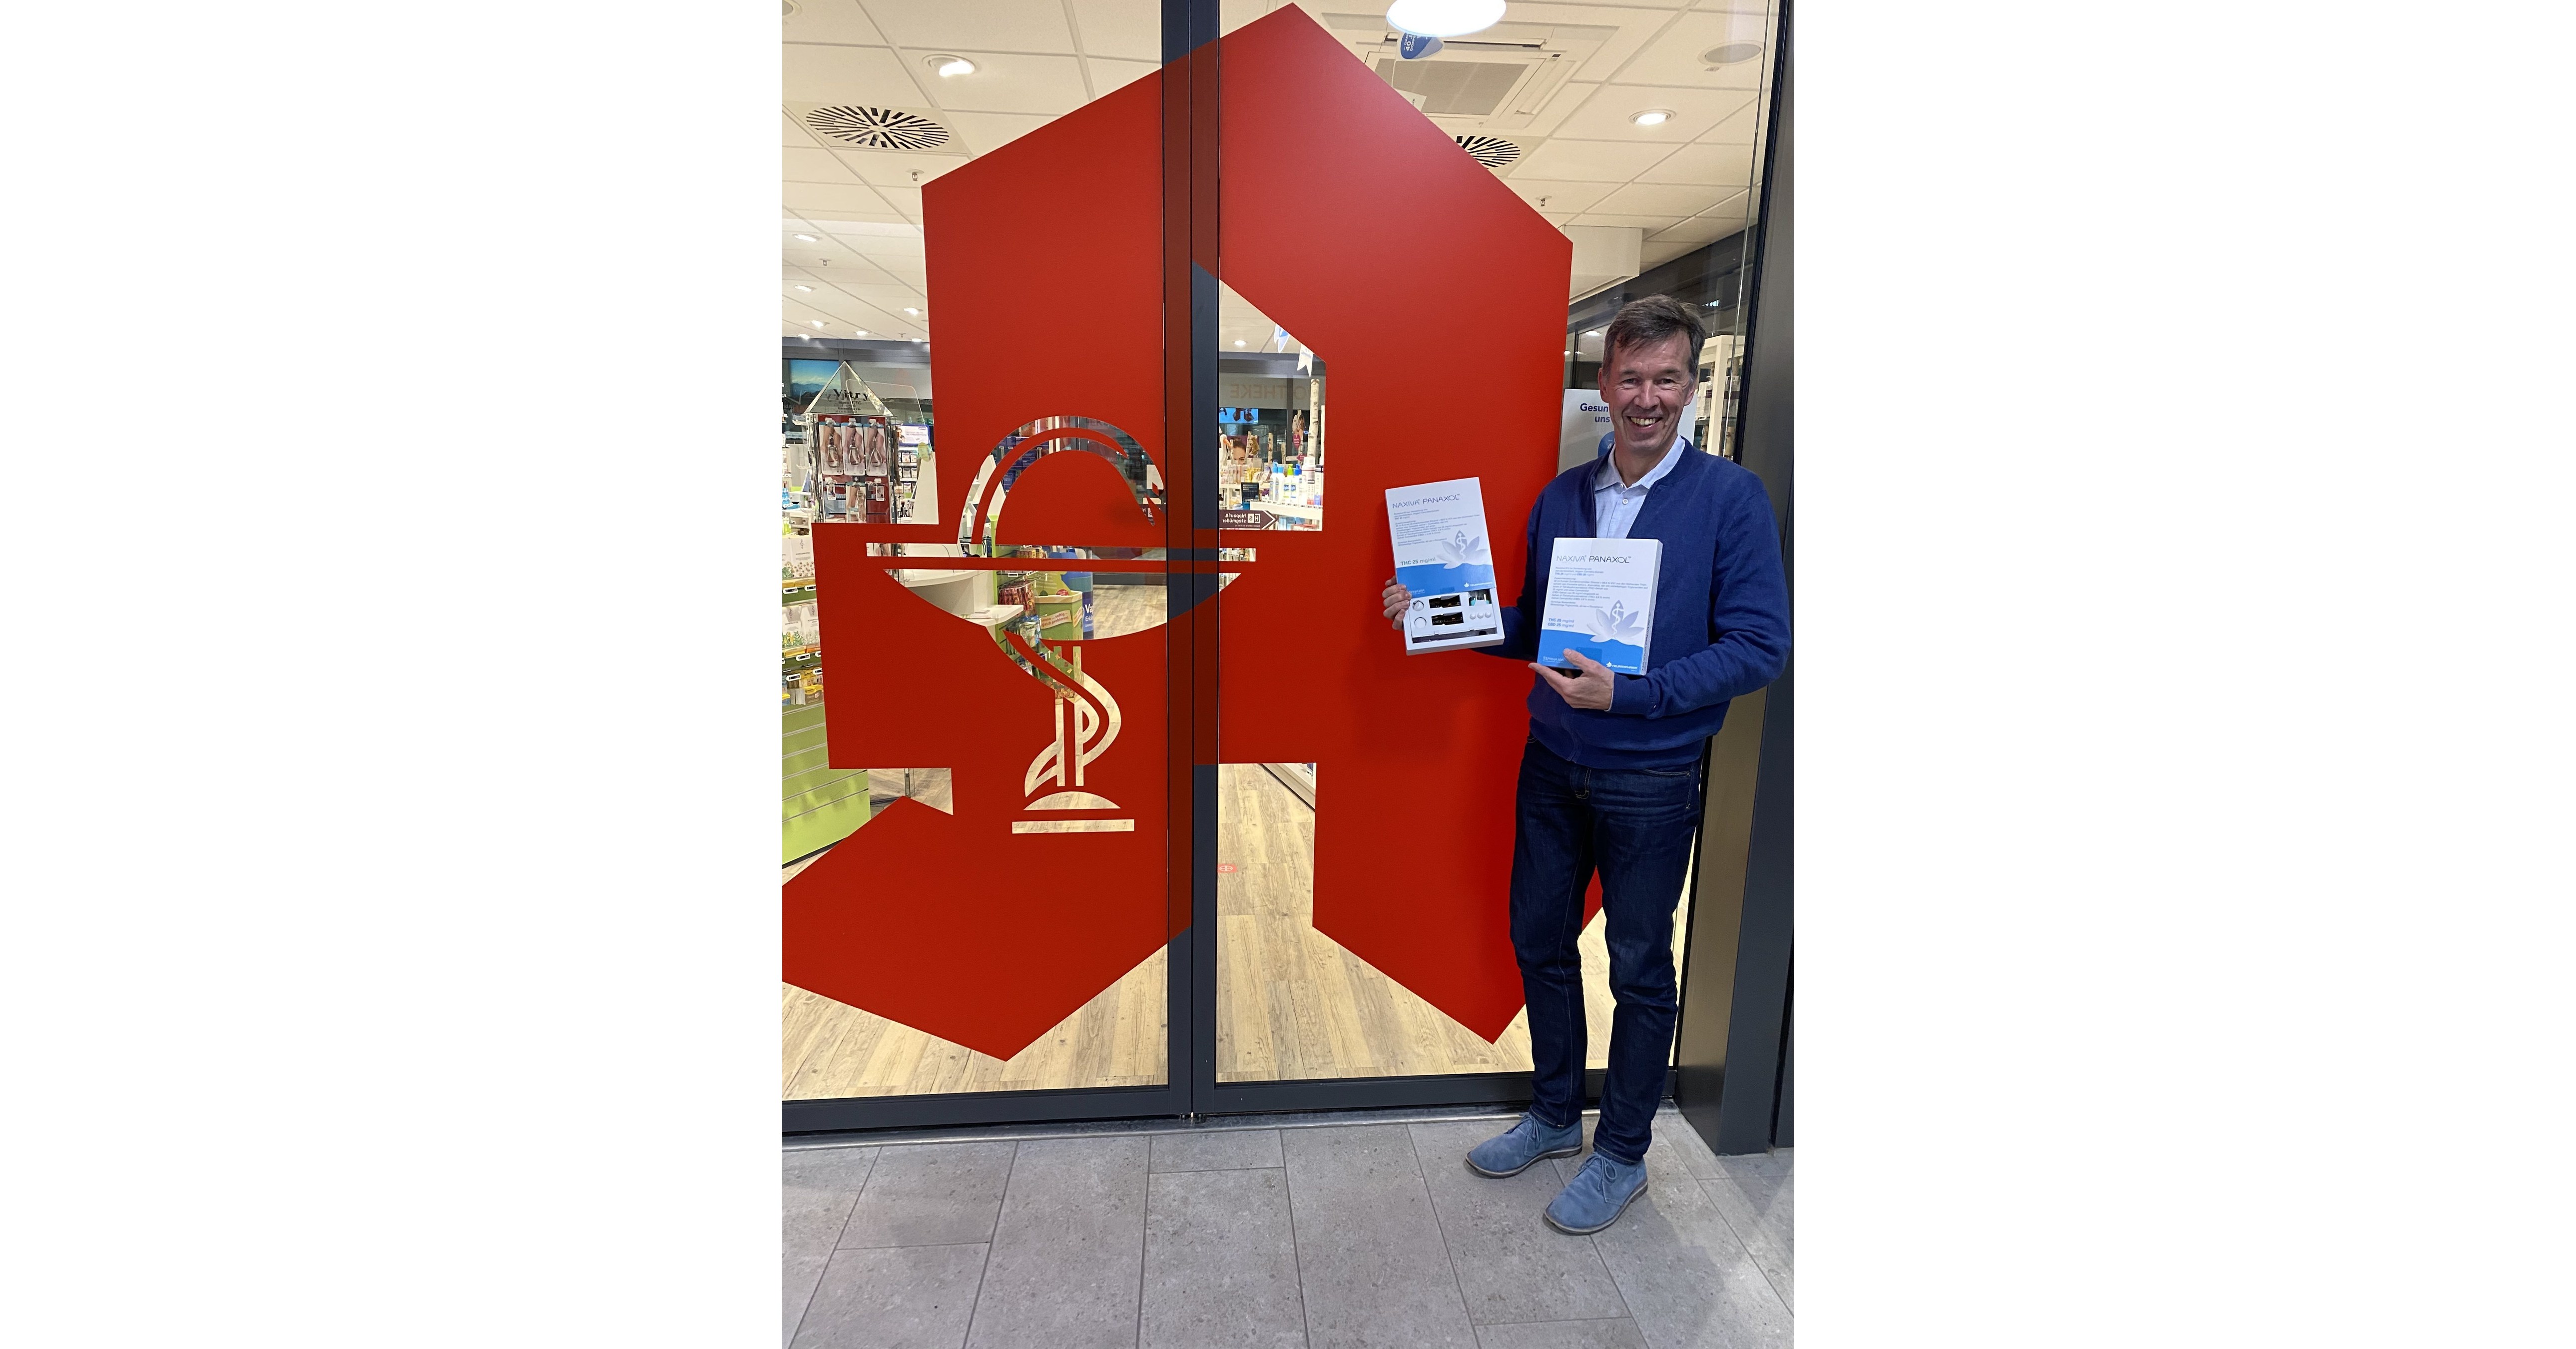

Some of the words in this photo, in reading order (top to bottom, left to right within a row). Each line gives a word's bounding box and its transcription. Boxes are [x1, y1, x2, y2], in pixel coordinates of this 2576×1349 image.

[833, 389, 869, 401] Vitry
[1580, 403, 1608, 412] Gesun
[1085, 604, 1093, 614] Va
